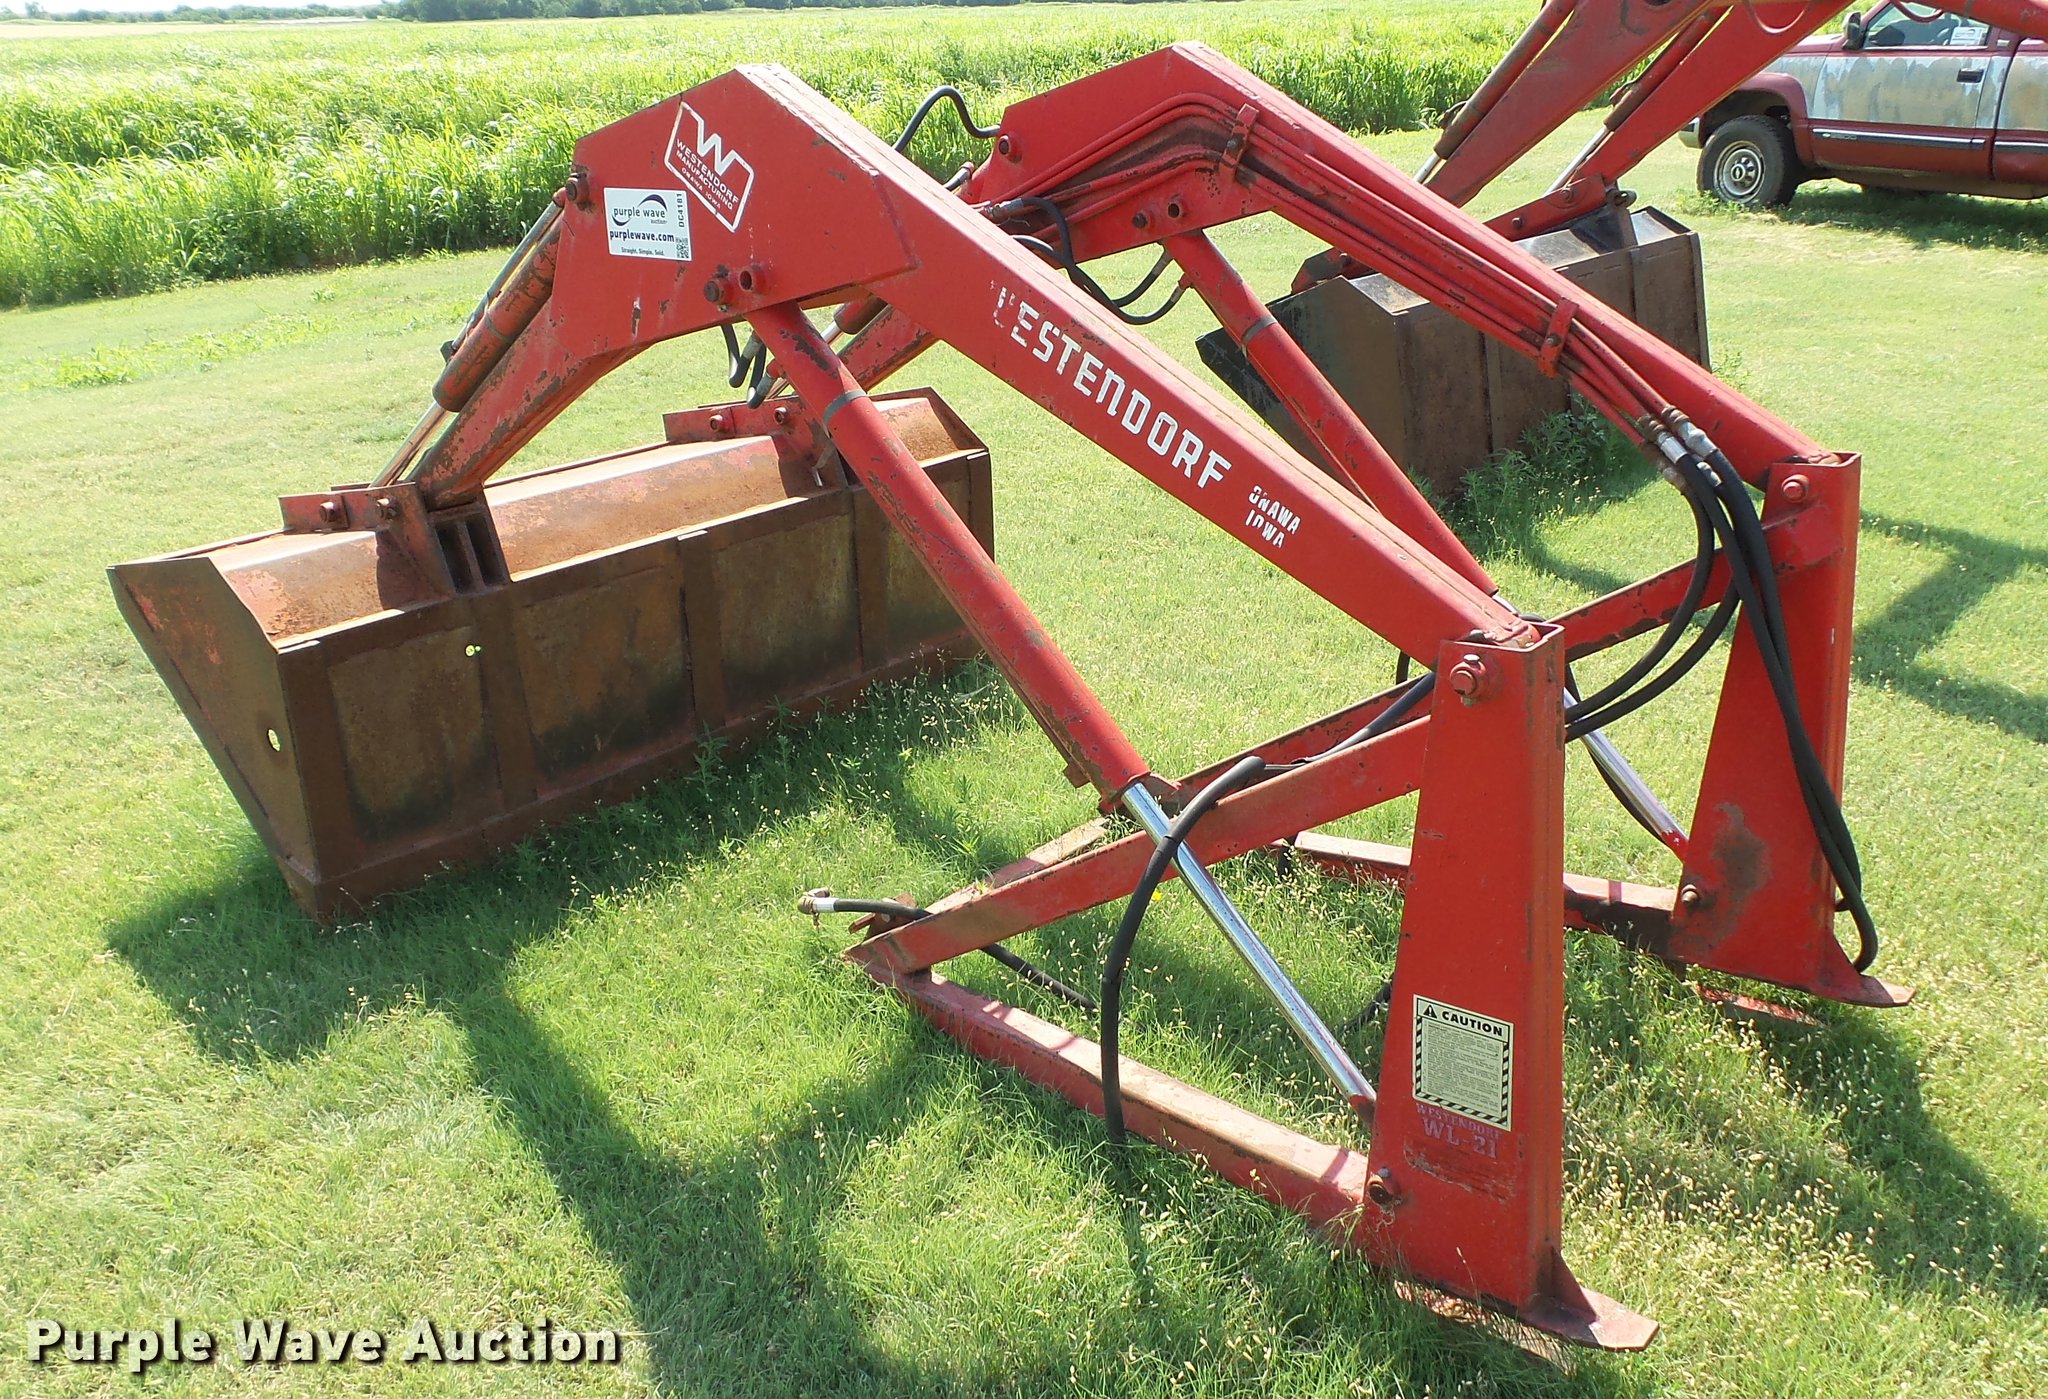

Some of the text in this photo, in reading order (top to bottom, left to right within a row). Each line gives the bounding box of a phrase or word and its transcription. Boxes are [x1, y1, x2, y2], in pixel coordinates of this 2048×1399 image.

[676, 138, 740, 204] WESTENDORF
[676, 150, 734, 210] MANUFACTURING
[613, 206, 666, 219] purple wave
[609, 228, 675, 242] purplewave.com
[1441, 1010, 1503, 1037] CAUTION
